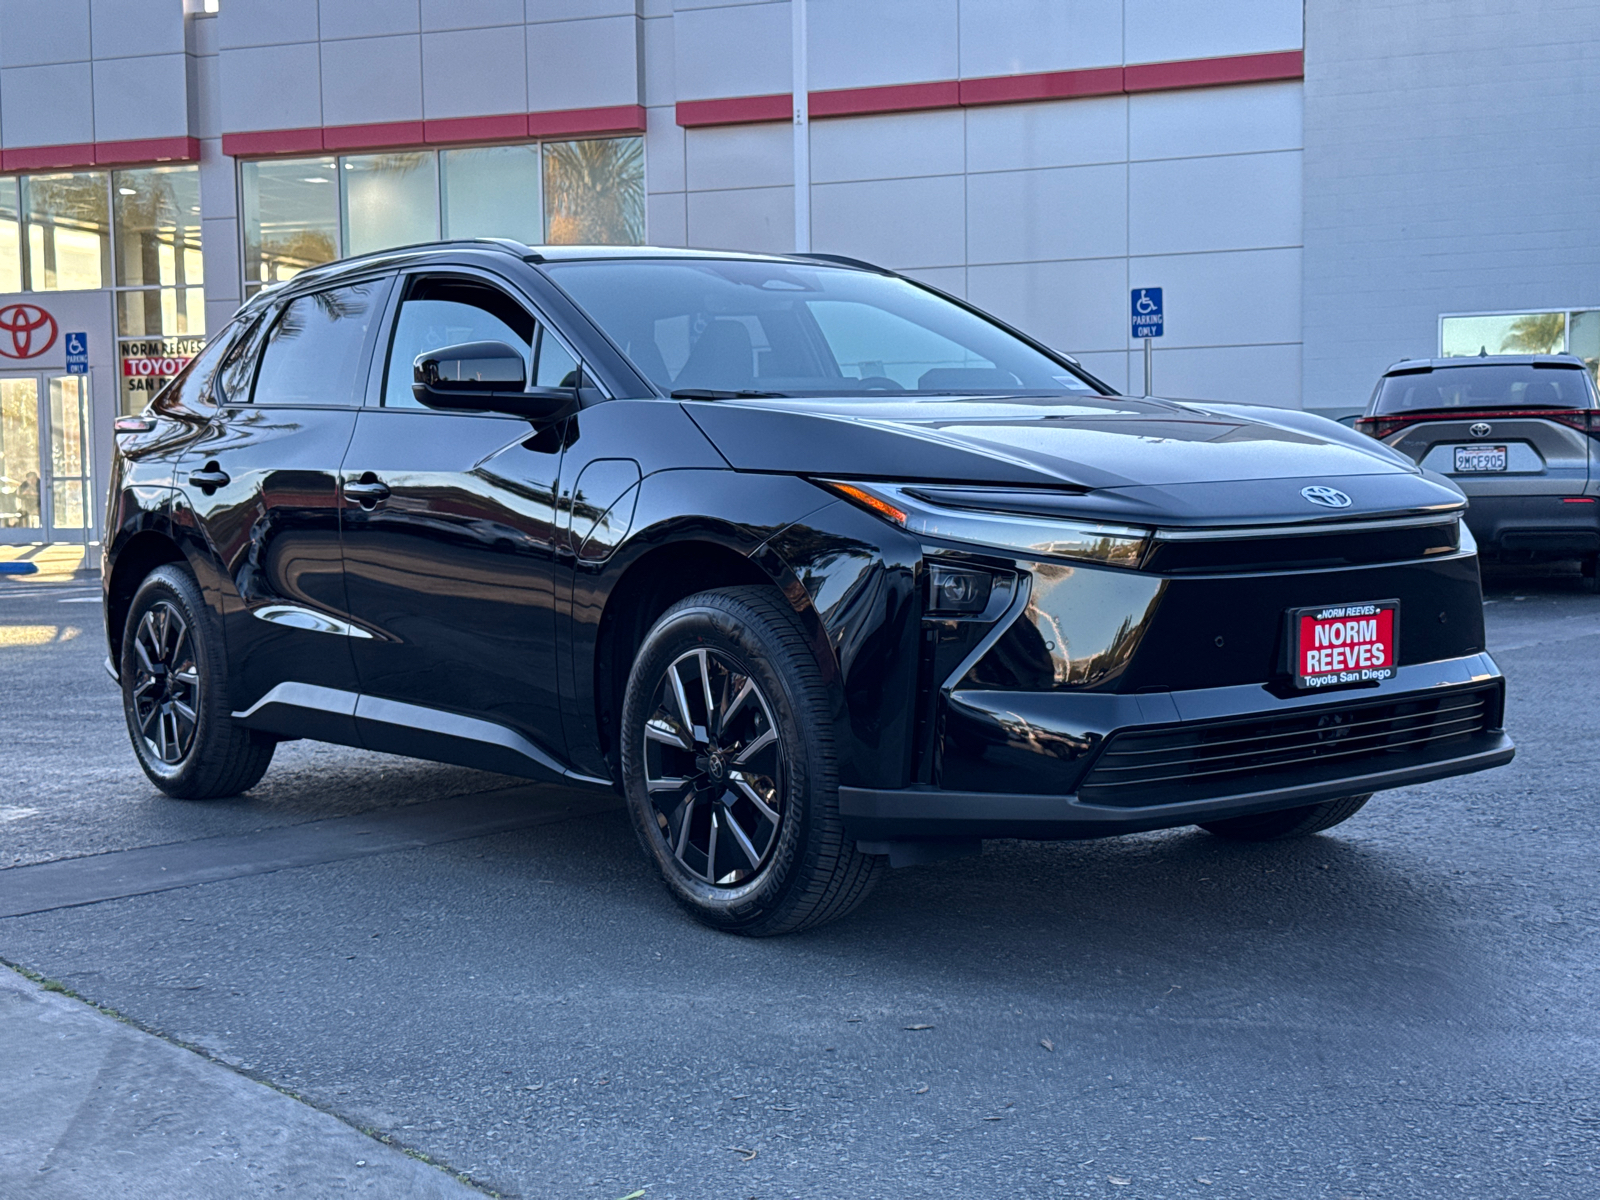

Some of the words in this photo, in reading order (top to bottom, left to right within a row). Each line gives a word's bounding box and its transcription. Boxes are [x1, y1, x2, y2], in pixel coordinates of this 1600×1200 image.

[1133, 314, 1162, 325] PARKING
[1138, 326, 1157, 336] ONLY
[122, 342, 159, 356] NORM
[162, 341, 202, 355] REEVES
[67, 354, 88, 363] PARKING
[70, 364, 84, 373] ONLY
[129, 379, 154, 391] SAN
[1458, 455, 1504, 468] 9MCE905
[1322, 607, 1345, 619] NORM
[1346, 605, 1375, 618] REEVES
[1315, 619, 1377, 647] NORM
[1307, 643, 1385, 673] REEVES
[1304, 674, 1338, 687] Toyota
[1339, 672, 1359, 682] San
[1362, 669, 1391, 680] Diego
[763, 759, 805, 902] BRIDGESTONE
